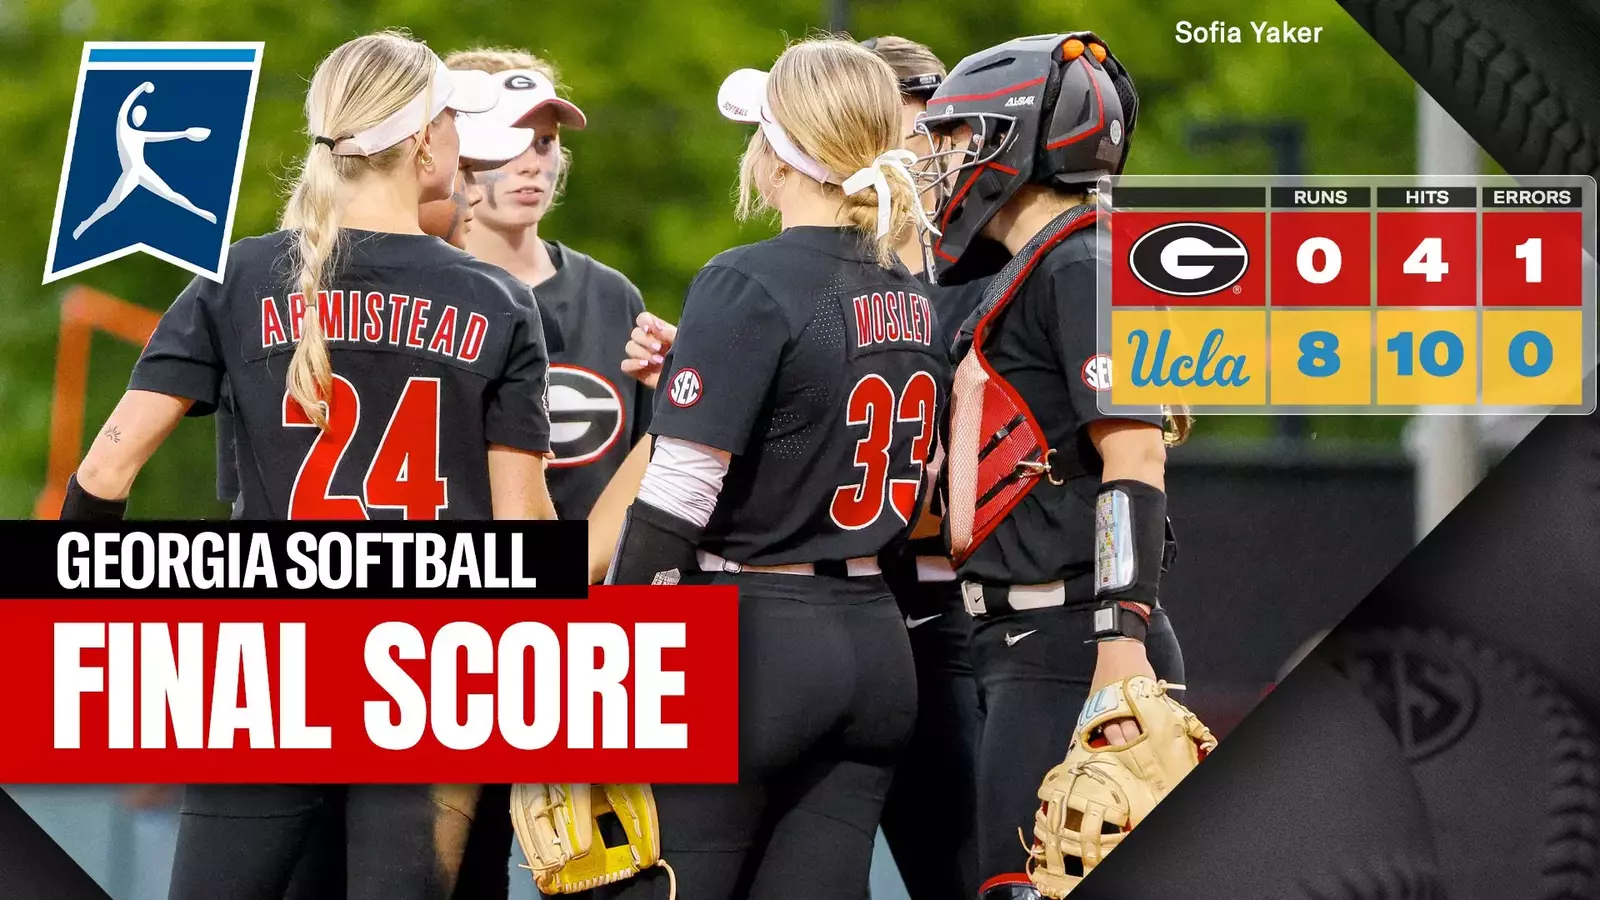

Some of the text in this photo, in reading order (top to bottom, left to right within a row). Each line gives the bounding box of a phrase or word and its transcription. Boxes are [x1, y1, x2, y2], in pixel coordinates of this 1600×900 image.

[722, 101, 749, 117] SOFTBALL
[853, 291, 931, 347] MOSLEY
[670, 370, 700, 405] SEC
[1084, 356, 1112, 389] SE
[282, 373, 449, 520] 24
[829, 371, 937, 530] 33
